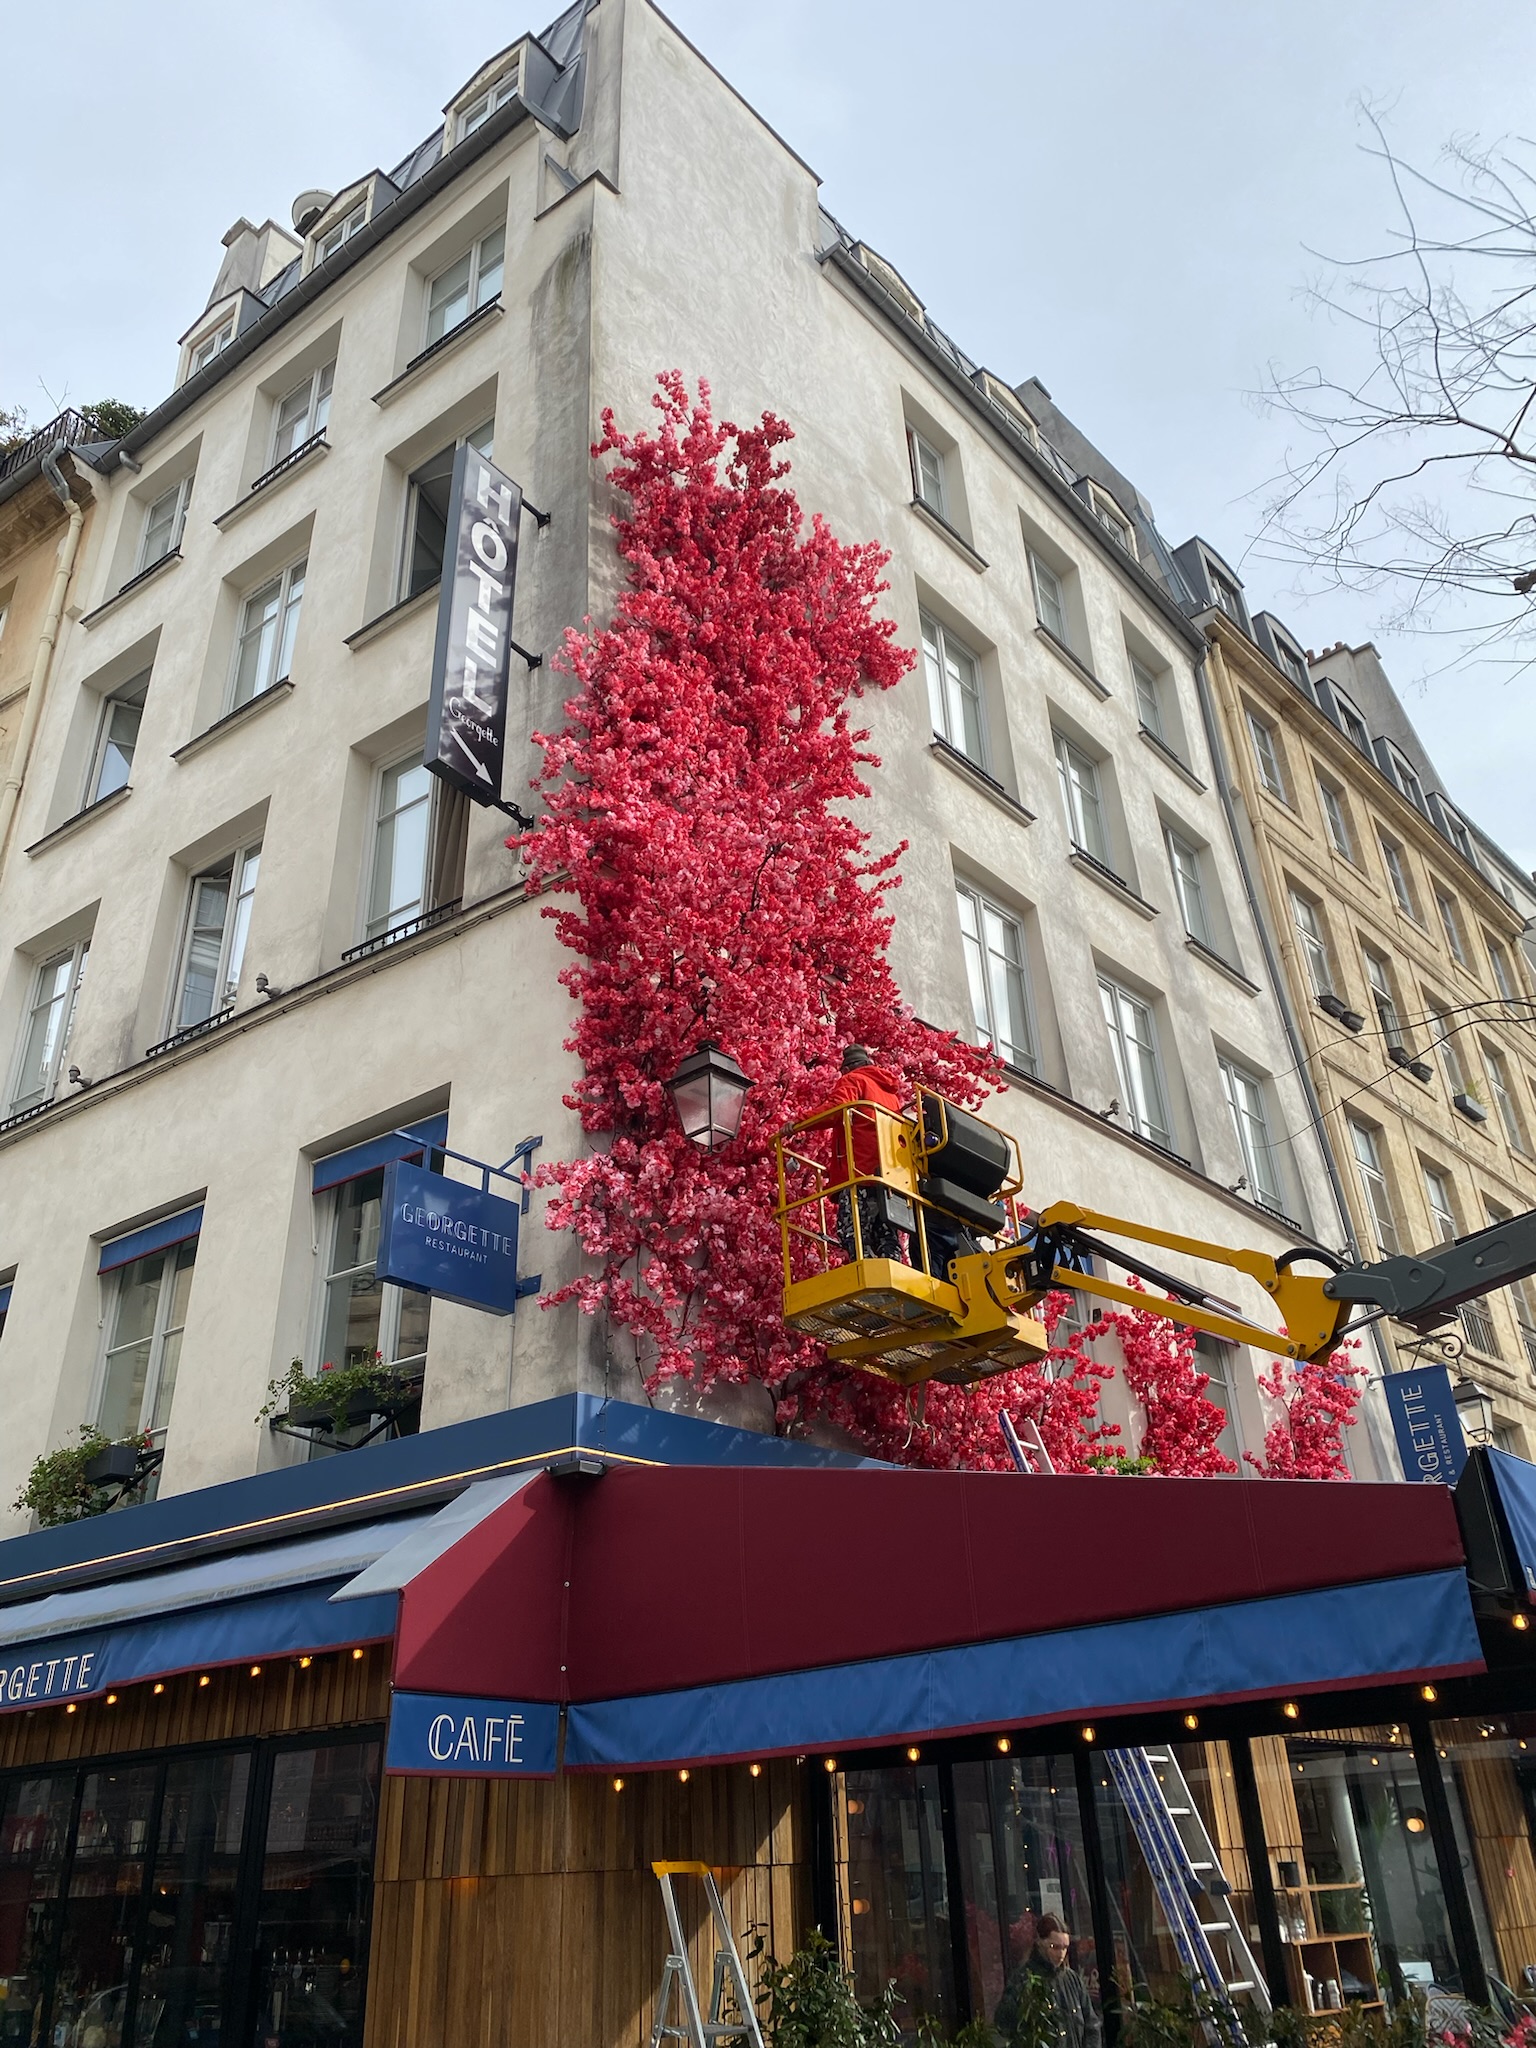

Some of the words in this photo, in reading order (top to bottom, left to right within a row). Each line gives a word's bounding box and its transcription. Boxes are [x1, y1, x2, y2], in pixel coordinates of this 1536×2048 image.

[462, 465, 513, 718] HÔTEL
[449, 696, 499, 747] Georgette
[401, 1202, 513, 1257] GEORGETTE
[425, 1236, 488, 1264] RESTAURANT
[1434, 1414, 1453, 1465] RESTAURANT
[428, 1714, 525, 1763] CAFÉ
